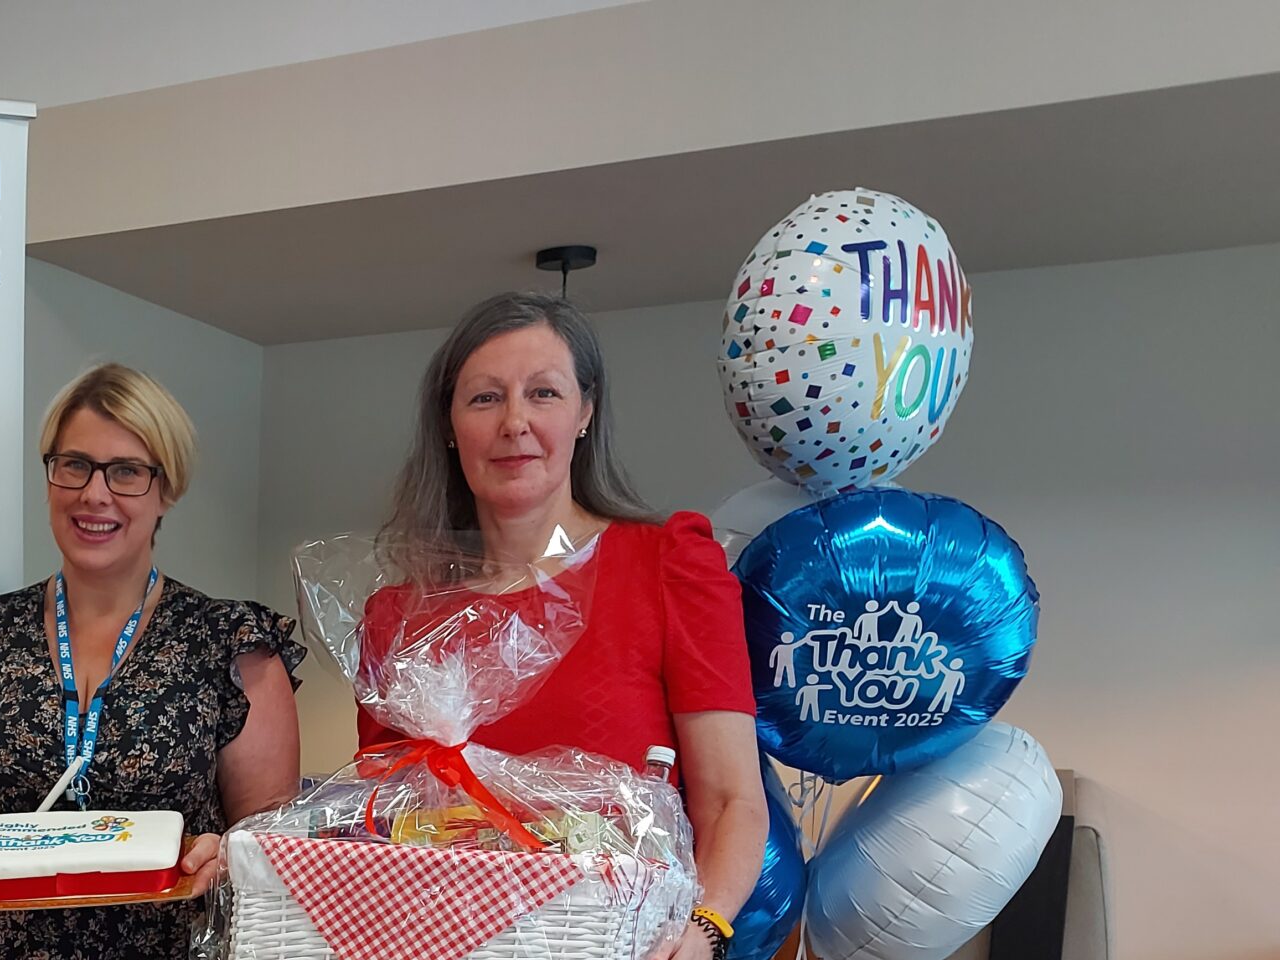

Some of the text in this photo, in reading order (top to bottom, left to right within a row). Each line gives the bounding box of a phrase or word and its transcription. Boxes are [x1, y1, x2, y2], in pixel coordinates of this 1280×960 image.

[871, 332, 958, 425] YOU
[56, 600, 65, 617] NHS
[807, 603, 846, 623] The
[57, 621, 68, 638] NHS
[123, 619, 138, 636] NHS
[60, 642, 71, 659] NHS
[115, 638, 128, 658] NHS
[809, 631, 943, 675] Thank
[62, 663, 73, 680] NHS
[67, 716, 77, 737] NHS
[86, 711, 98, 732] NHS
[823, 709, 944, 727] Event 2025
[83, 740, 93, 762] NHS
